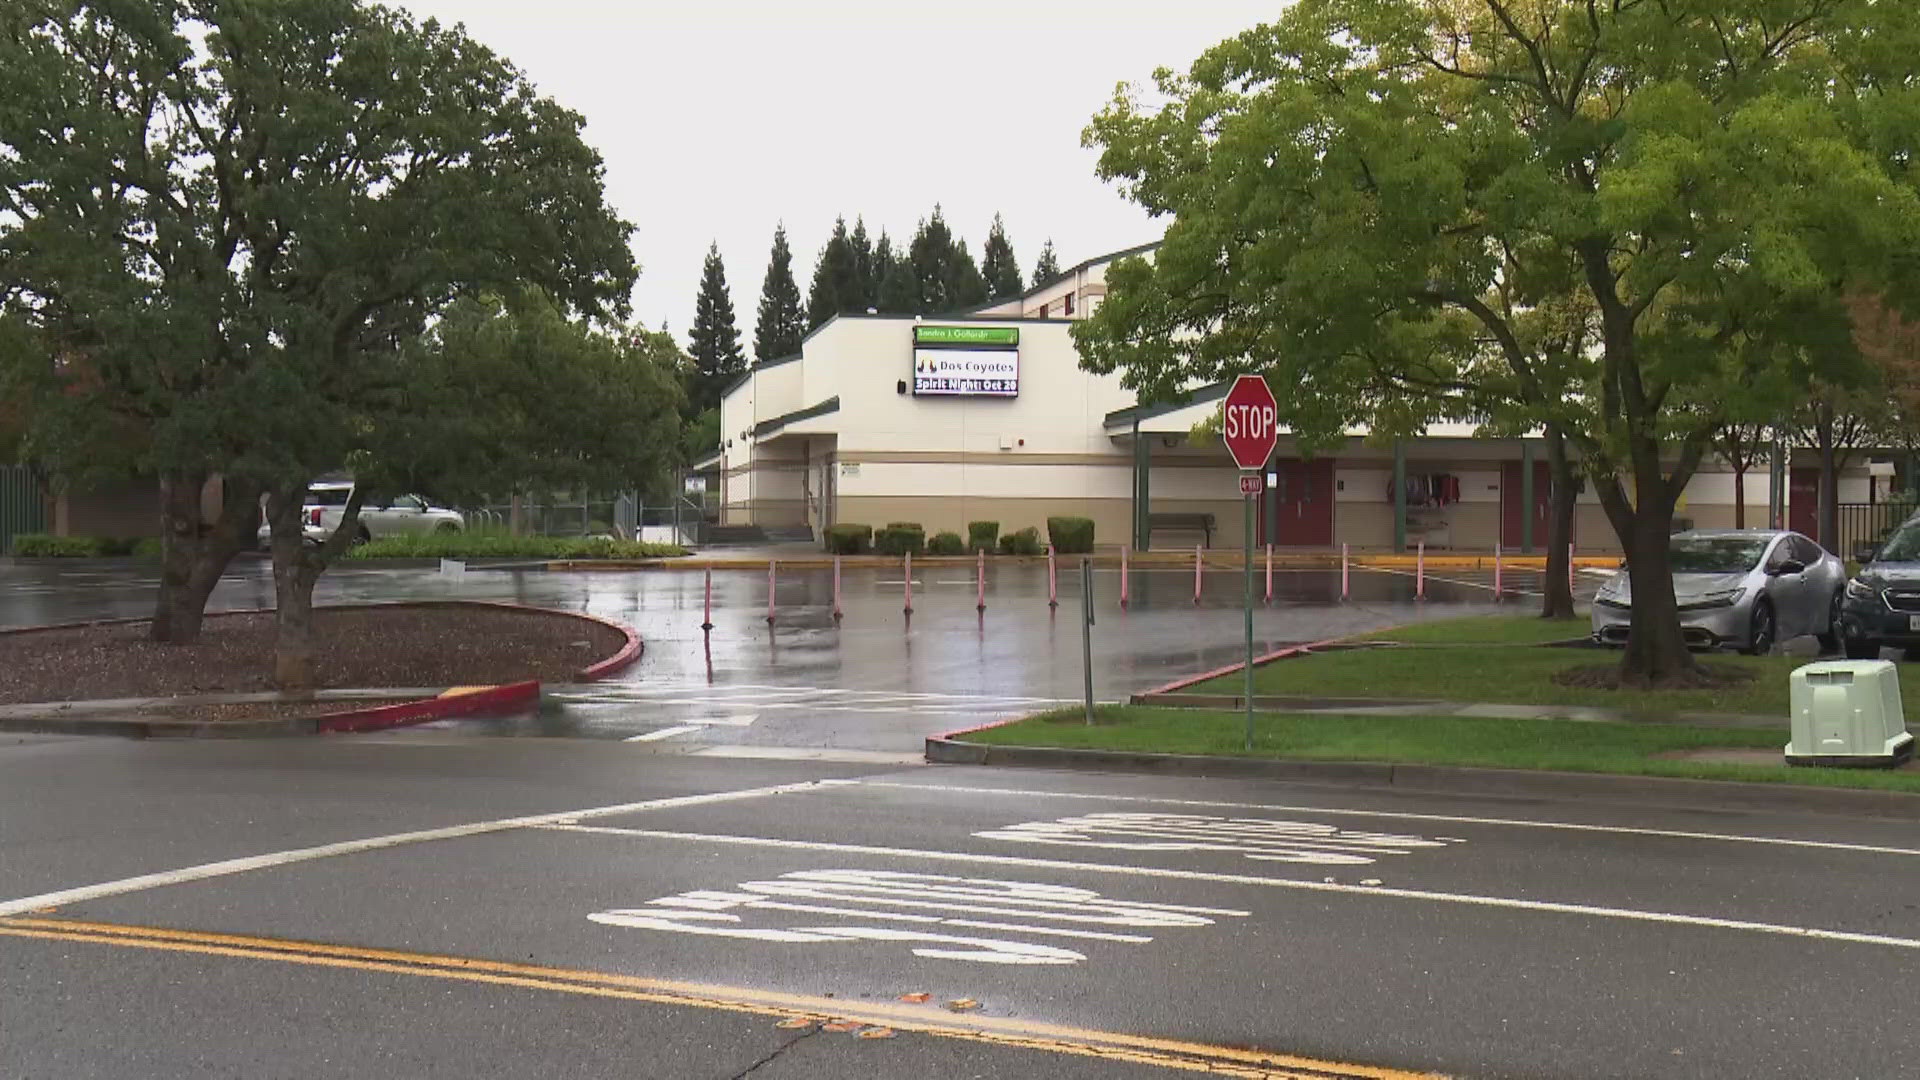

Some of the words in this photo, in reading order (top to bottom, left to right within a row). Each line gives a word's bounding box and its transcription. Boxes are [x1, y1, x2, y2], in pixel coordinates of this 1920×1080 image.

[918, 328, 945, 337] Sandra
[940, 361, 962, 371] Dos
[965, 361, 1014, 373] Coyotes
[916, 379, 947, 391] Spirit
[983, 380, 1002, 391] Oct
[1227, 405, 1274, 439] STOP
[1241, 478, 1260, 490] 4-WAY
[587, 869, 1251, 965] STOP
